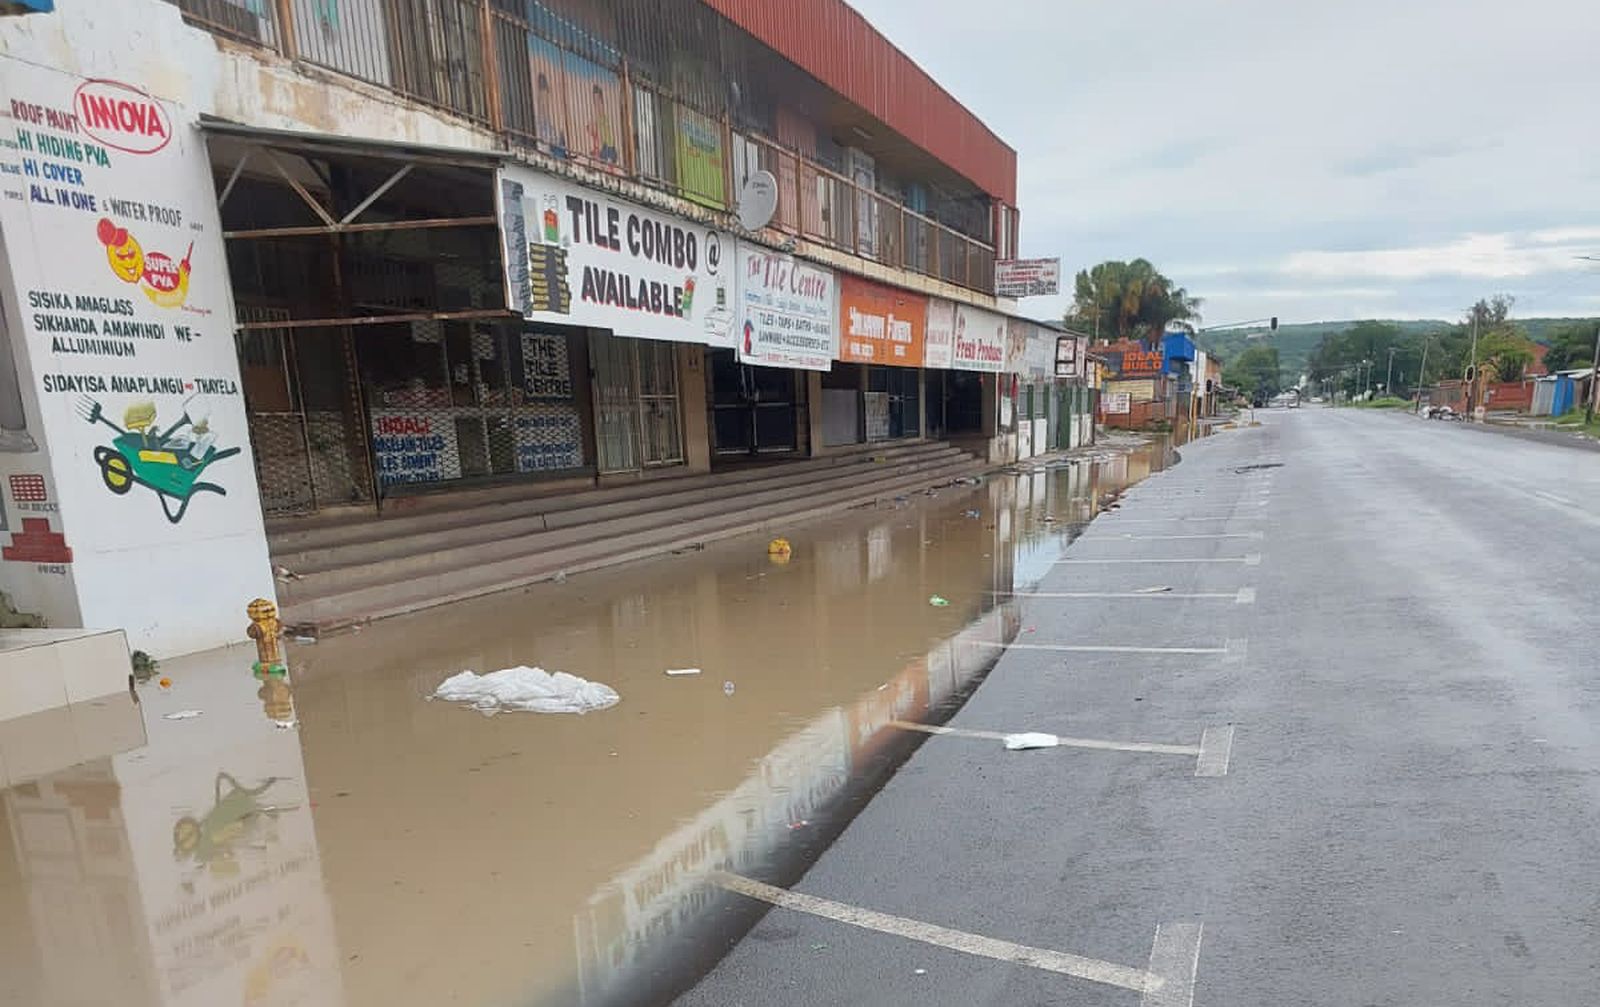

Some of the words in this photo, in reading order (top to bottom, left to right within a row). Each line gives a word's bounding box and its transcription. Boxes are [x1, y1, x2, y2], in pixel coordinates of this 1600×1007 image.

[11, 98, 43, 125] ROOF
[45, 107, 79, 133] PAINT
[80, 92, 166, 138] INNOVA
[17, 128, 33, 151] HI
[36, 132, 83, 162] HIDING
[84, 143, 111, 168] PVA
[23, 157, 39, 178] HI
[42, 162, 84, 186] COVER
[30, 183, 54, 204] ALL
[56, 188, 70, 207] IN
[71, 191, 97, 212] ONE
[110, 198, 145, 221] WATER
[149, 206, 182, 227] PROOF
[566, 195, 620, 252] TILE
[626, 213, 697, 271] COMBO
[145, 256, 177, 273] SUPER
[762, 254, 787, 292] Tile
[790, 262, 827, 301] Centre
[151, 273, 175, 287] PVA
[582, 265, 683, 319] AVAILABLE
[28, 291, 72, 309] SISIKA
[75, 296, 134, 317] AMAGLASS
[33, 314, 97, 335] SIKHANDA
[102, 319, 165, 340] AMAWINDI
[52, 337, 136, 357] ALLUMINIUM
[529, 339, 557, 358] THE
[43, 374, 107, 393] SIDAYISA
[111, 376, 184, 394] AMAPLANGU
[194, 378, 239, 395] THAYELA
